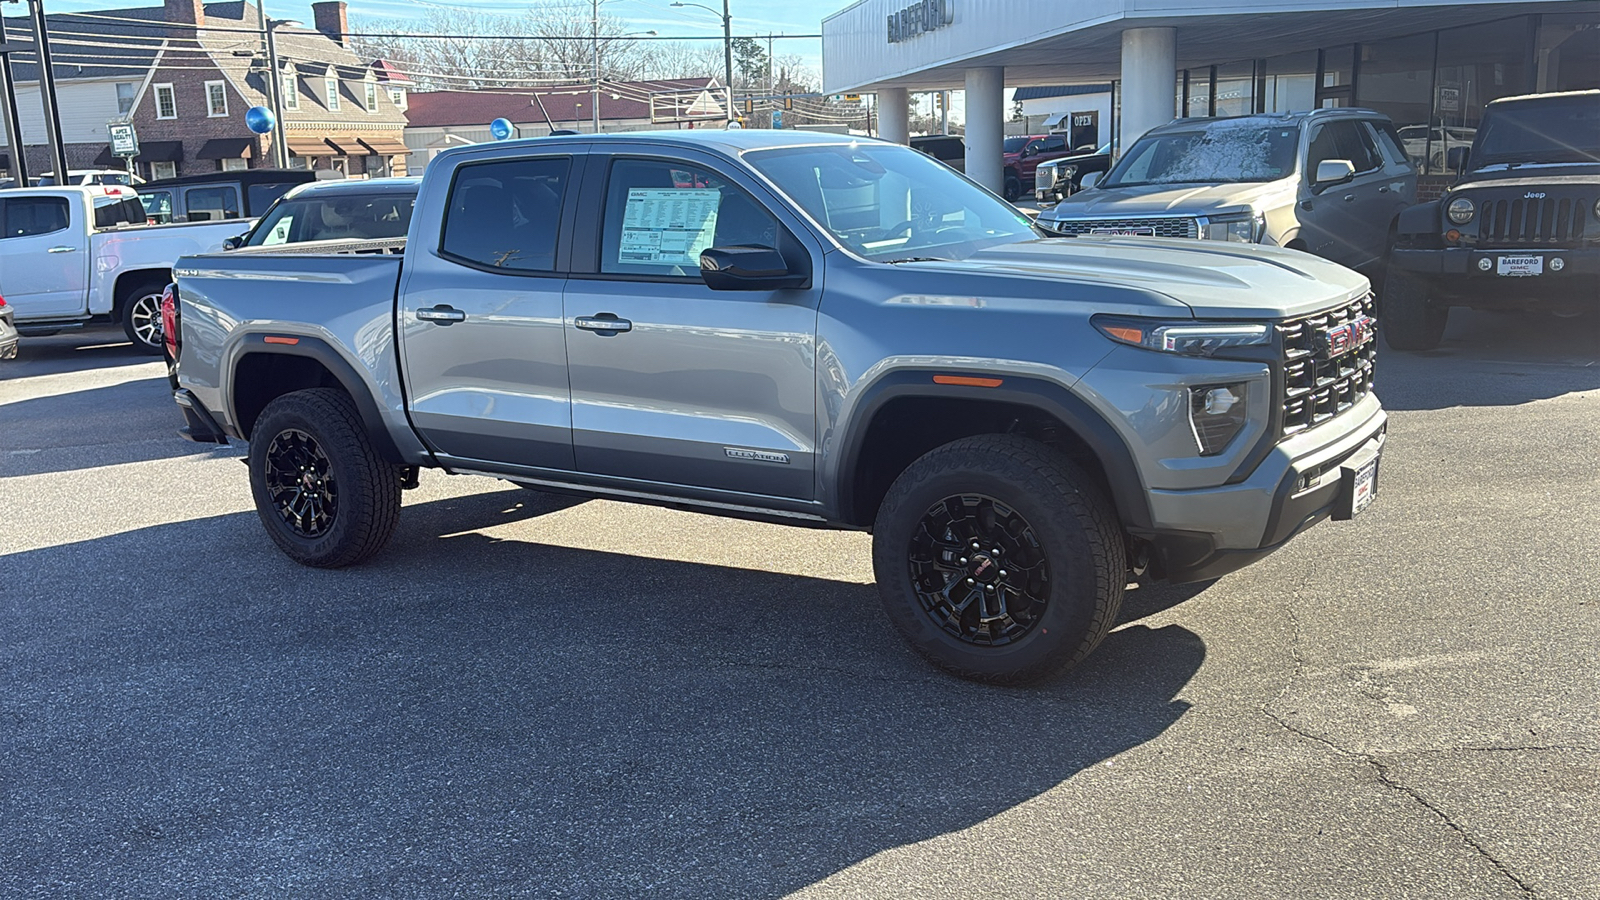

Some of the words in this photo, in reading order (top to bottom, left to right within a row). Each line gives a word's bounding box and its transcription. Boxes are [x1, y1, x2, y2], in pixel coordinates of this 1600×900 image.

[887, 0, 954, 43] BAREFORD
[1074, 115, 1092, 126] OPEN
[1523, 191, 1546, 199] Jeep
[1327, 317, 1373, 358] GMC
[728, 450, 784, 461] ELEVATION
